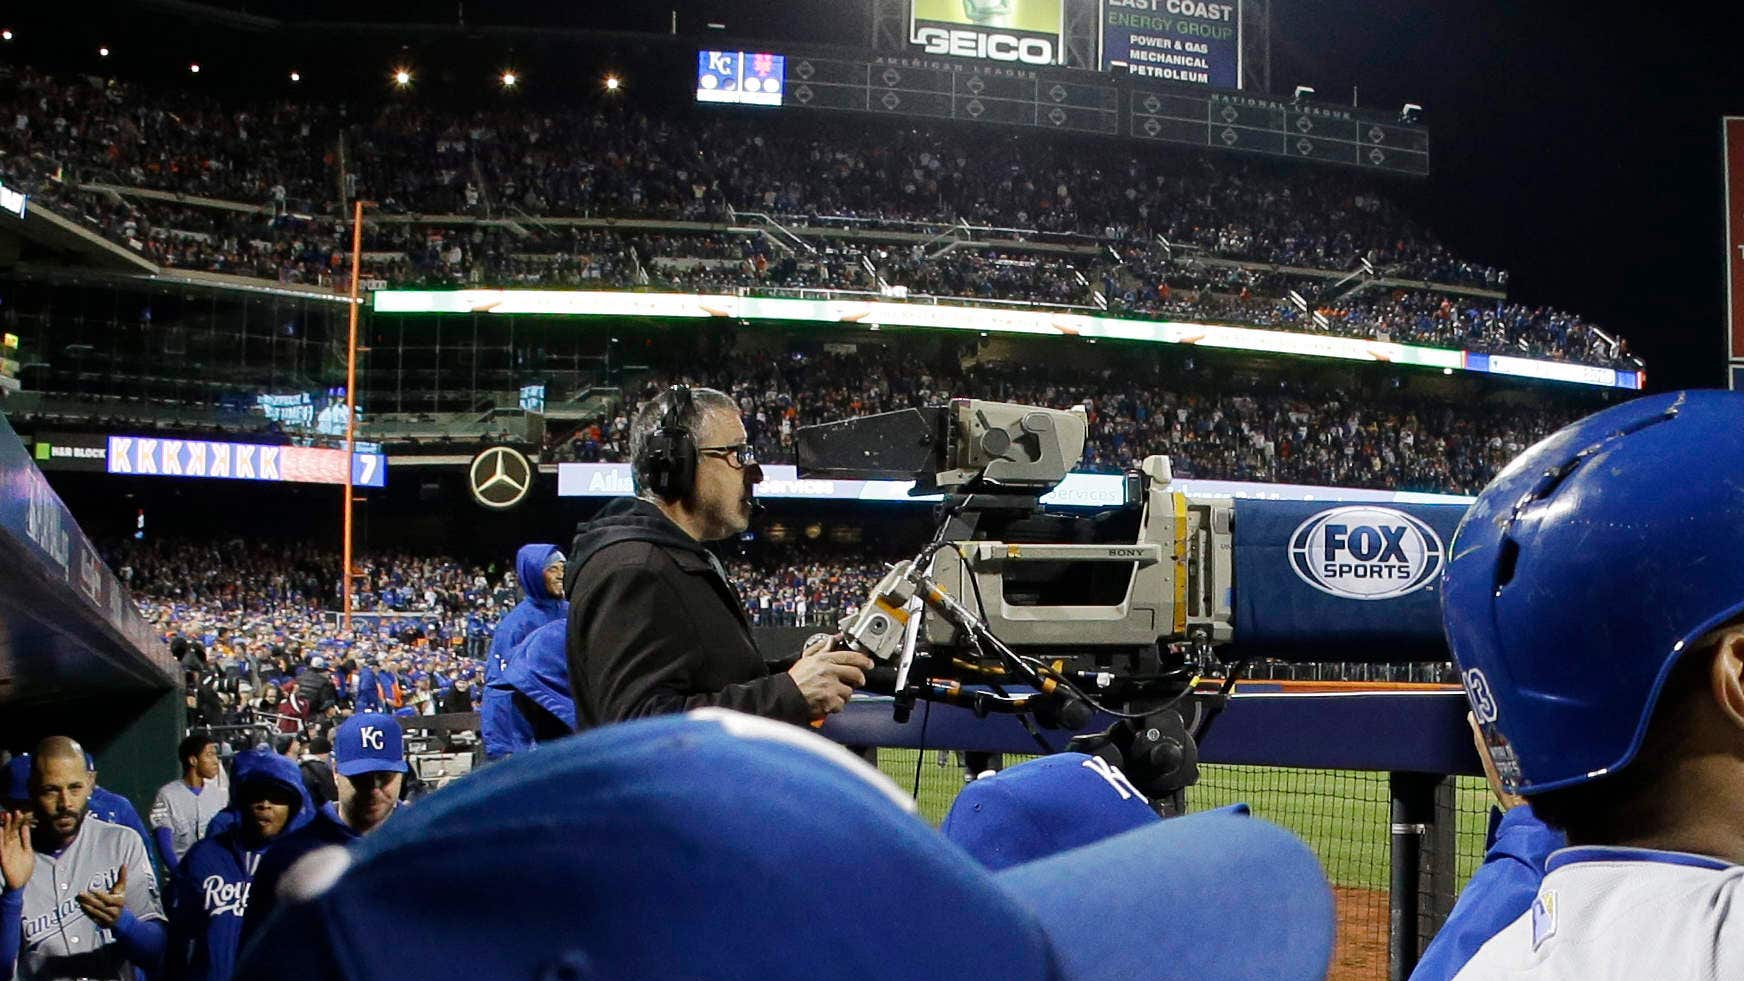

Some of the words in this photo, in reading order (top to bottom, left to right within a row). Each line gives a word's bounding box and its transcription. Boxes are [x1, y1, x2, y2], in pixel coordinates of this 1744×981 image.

[1167, 0, 1233, 21] COAST
[1108, 11, 1172, 31] ENERGY
[1176, 20, 1233, 40] GROUP
[1130, 34, 1172, 50] POWER
[1174, 40, 1183, 51] &
[1185, 41, 1208, 54] GAS
[1130, 49, 1209, 69] MECHANICAL
[1130, 64, 1208, 84] PETROLEUM
[74, 447, 107, 459] BLOCK
[358, 453, 377, 485] 7
[1108, 548, 1145, 557] SONY
[1324, 524, 1408, 563] FOX
[1323, 563, 1410, 580] SPORTS
[360, 726, 385, 750] KC
[87, 868, 120, 893] Cit
[203, 874, 251, 916] Roy
